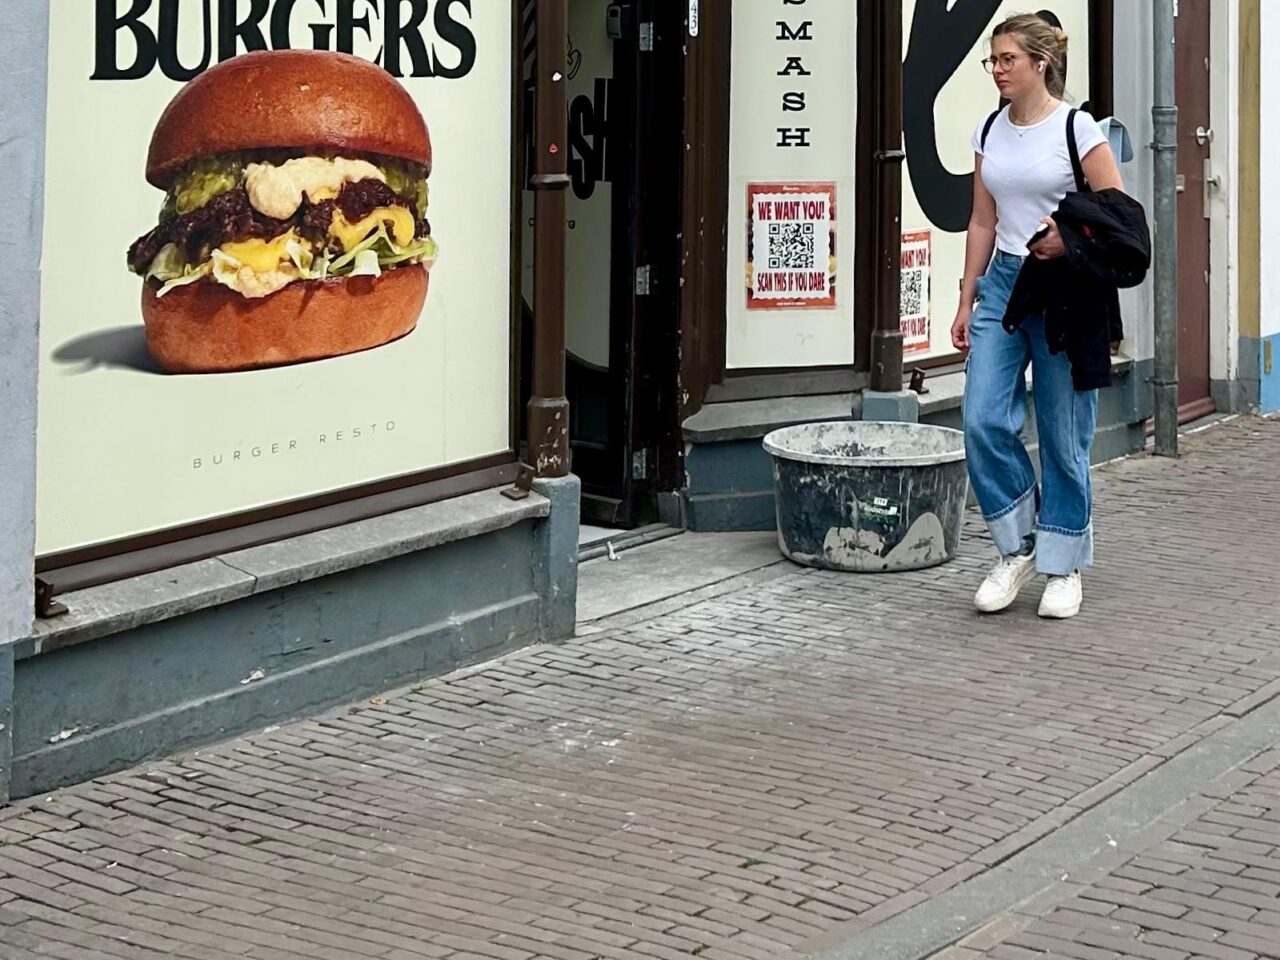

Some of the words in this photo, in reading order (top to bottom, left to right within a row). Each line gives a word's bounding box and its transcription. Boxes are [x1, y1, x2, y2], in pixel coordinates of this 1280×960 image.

[758, 202, 772, 220] WE
[774, 202, 801, 220] WANT
[802, 201, 825, 220] YOU!
[757, 272, 773, 292] SCAN
[774, 272, 787, 292] THIS
[788, 272, 794, 292] IF
[794, 272, 808, 292] YOU
[809, 272, 825, 291] DARE
[193, 440, 297, 468] BURGER
[319, 421, 395, 443] RESTO
